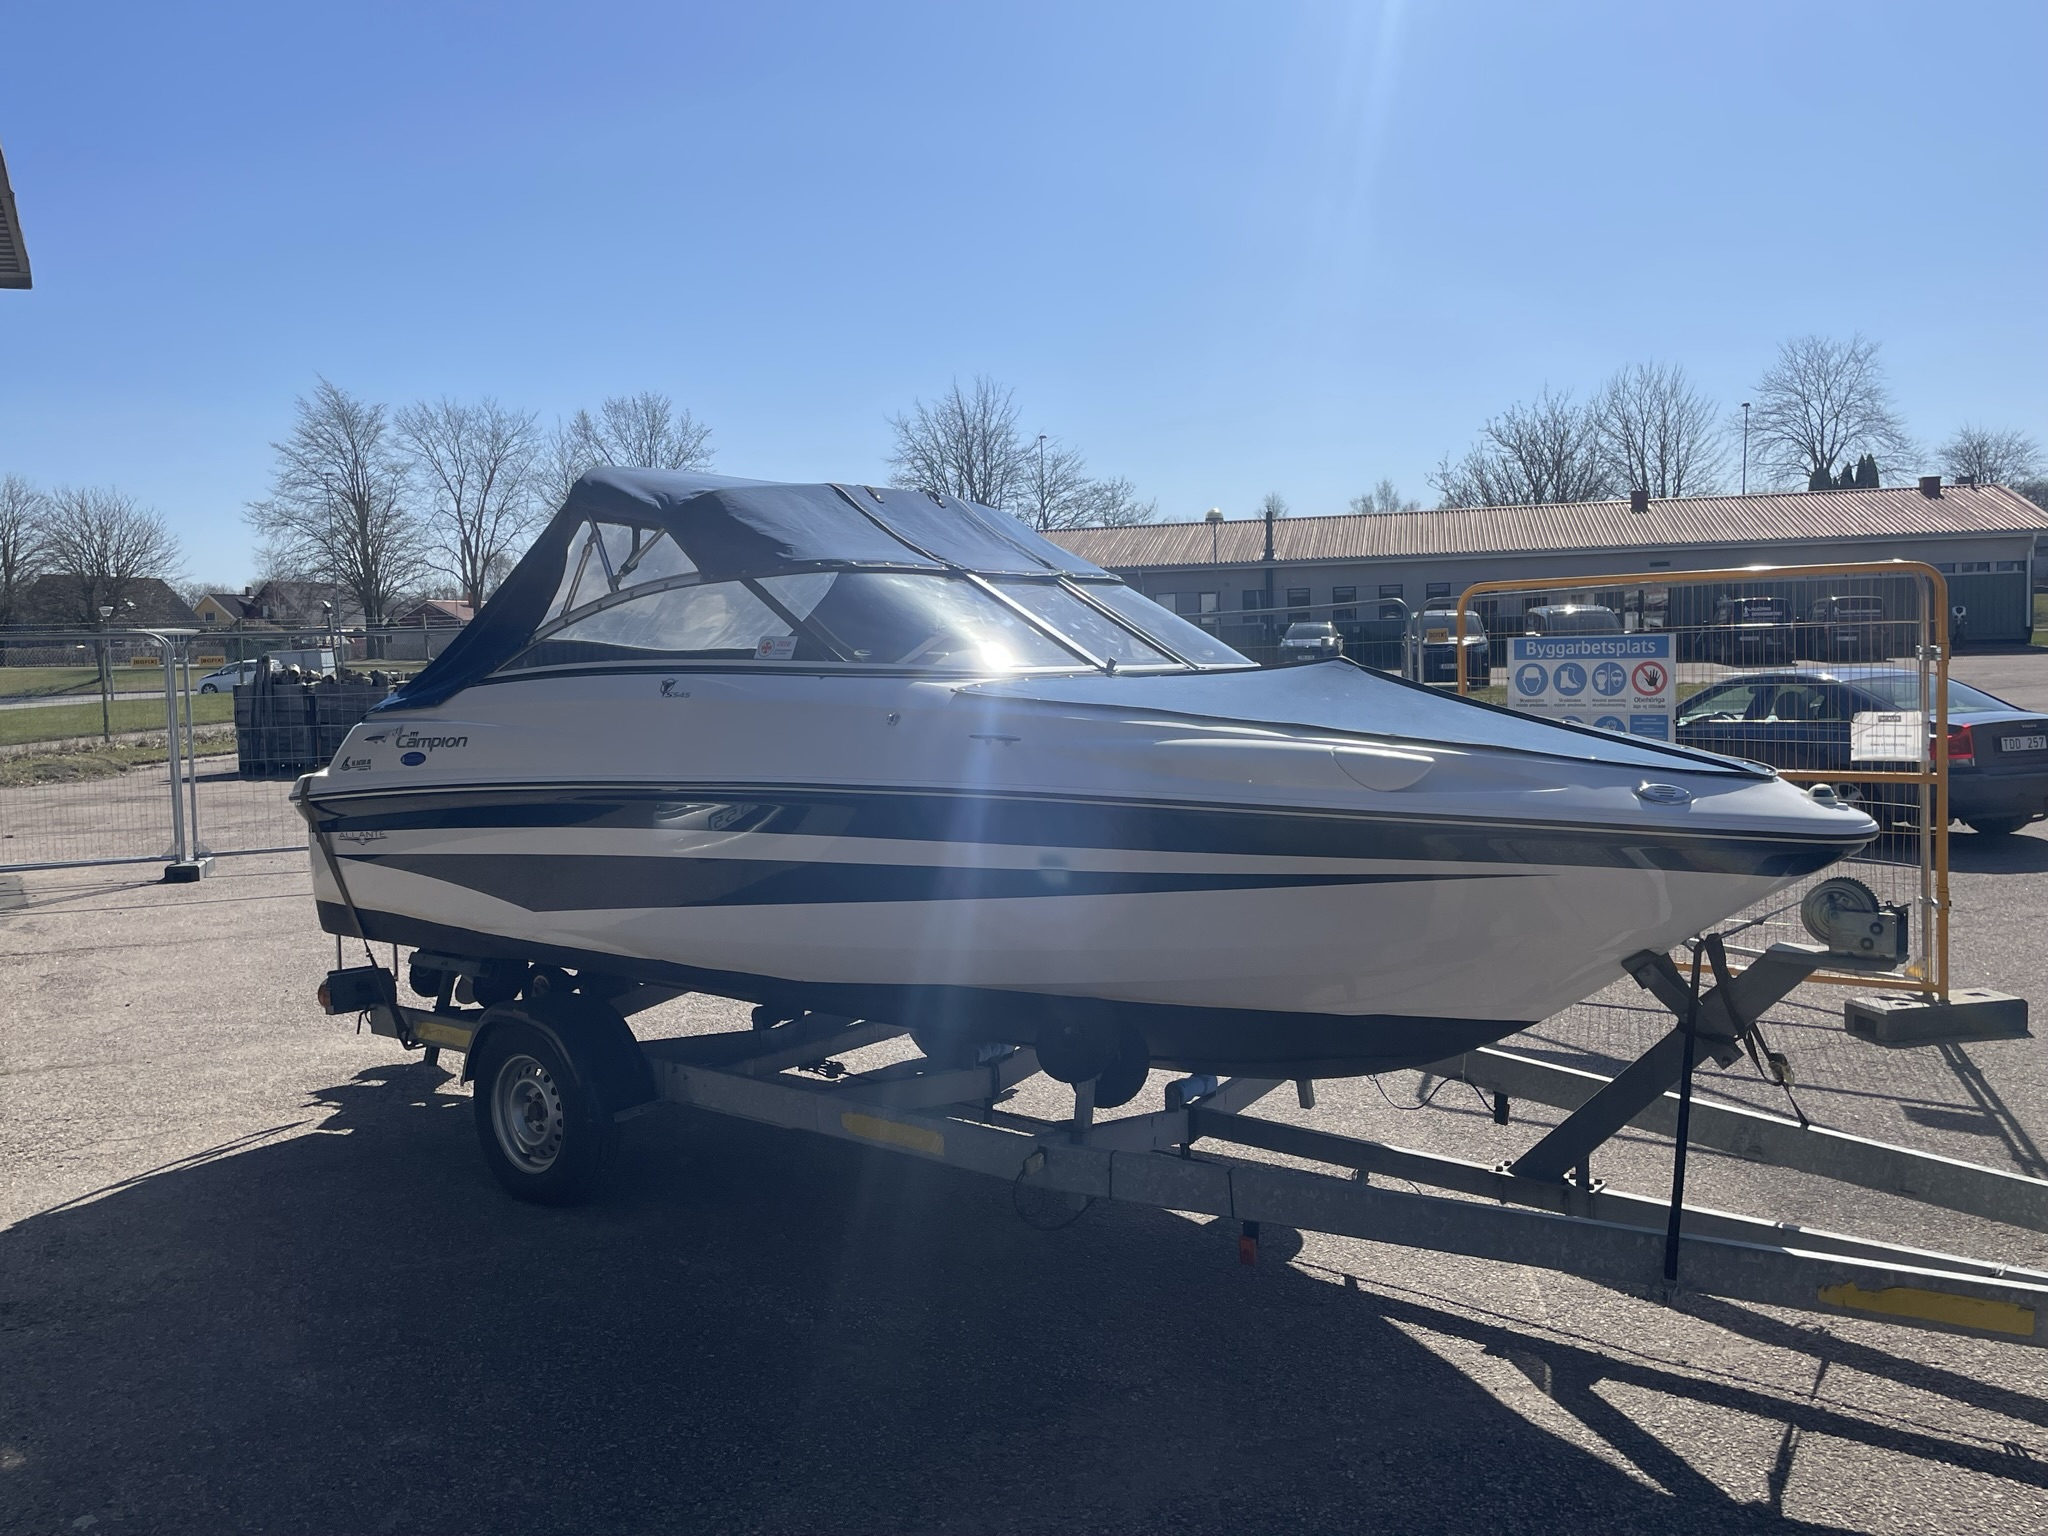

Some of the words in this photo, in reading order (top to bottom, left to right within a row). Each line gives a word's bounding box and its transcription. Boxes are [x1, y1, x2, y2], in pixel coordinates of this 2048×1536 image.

[1526, 639, 1656, 658] Byggarbetsplats
[1634, 696, 1665, 704] Obehöriga
[396, 734, 468, 752] Campion
[2003, 738, 2021, 750] TDD
[2027, 737, 2044, 748] 257
[339, 830, 387, 839] ALLANTE
